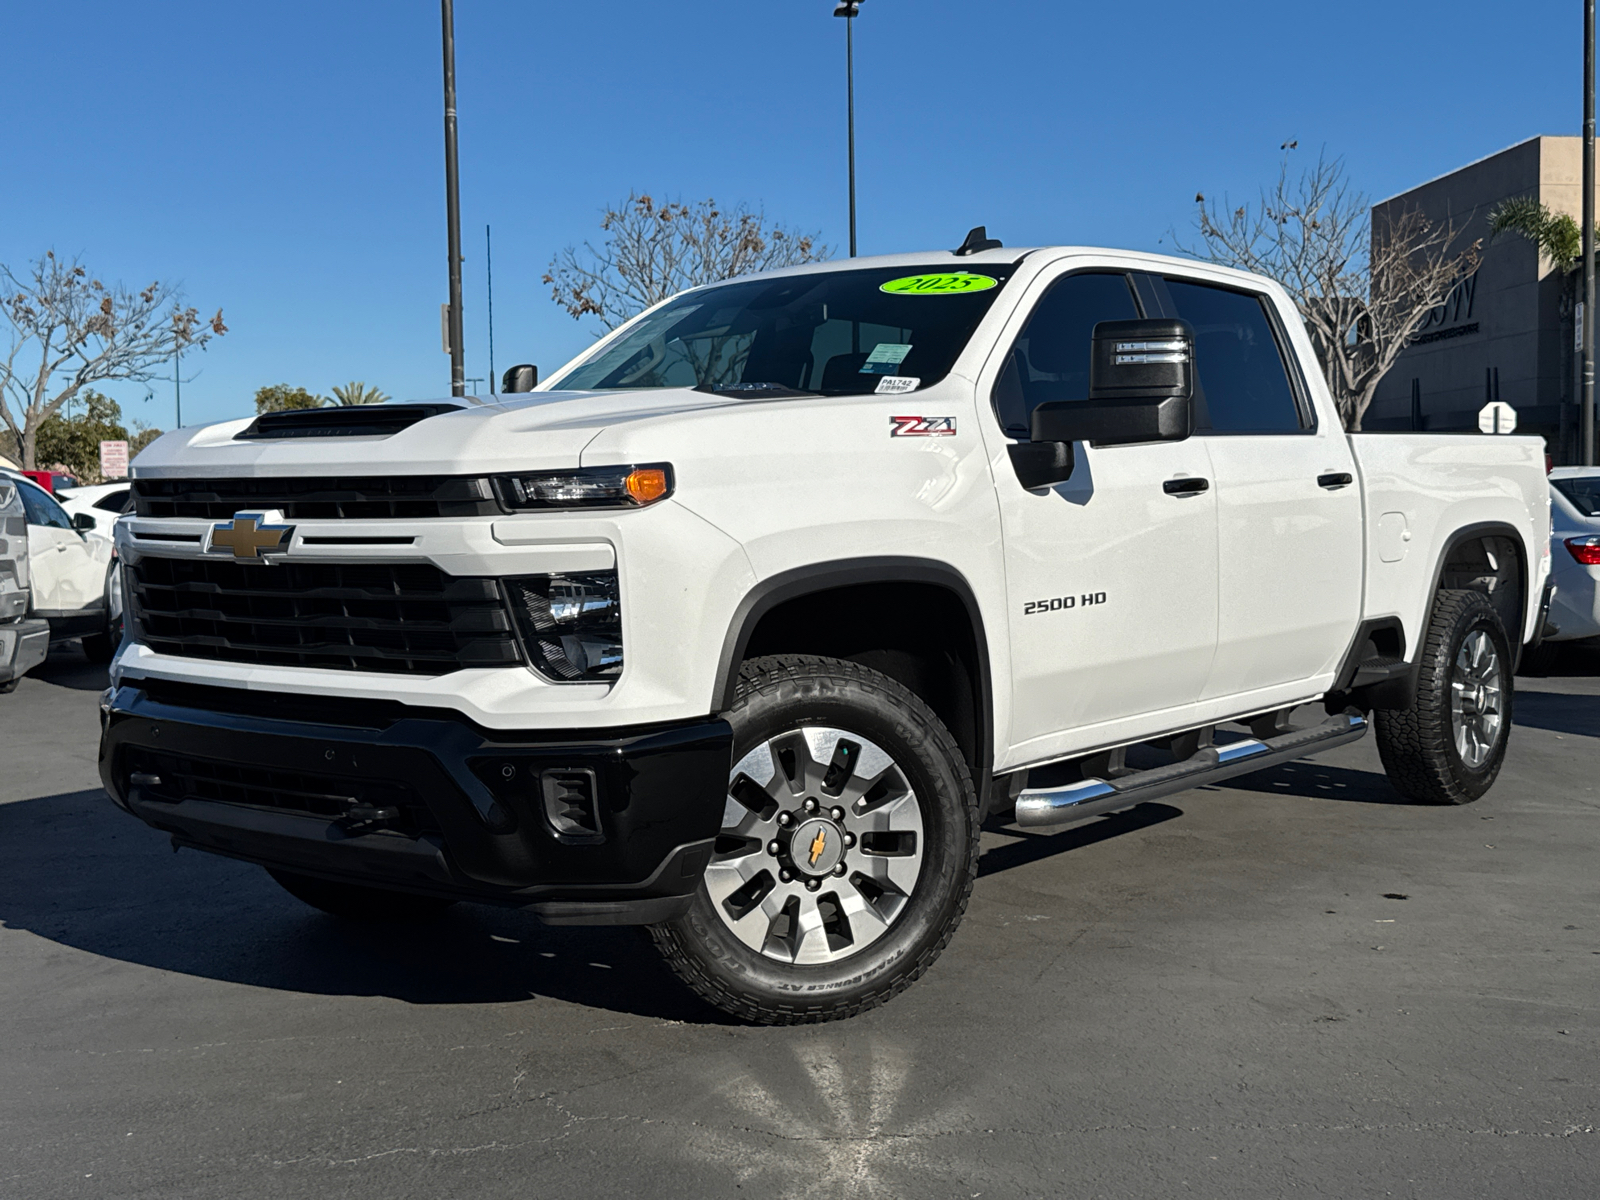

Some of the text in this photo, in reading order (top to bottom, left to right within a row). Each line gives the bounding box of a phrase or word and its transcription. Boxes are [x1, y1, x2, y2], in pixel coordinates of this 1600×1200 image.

[895, 277, 981, 291] 2025
[881, 378, 913, 387] PA1742
[889, 416, 956, 438] Z71
[1023, 591, 1107, 615] 2500 HD
